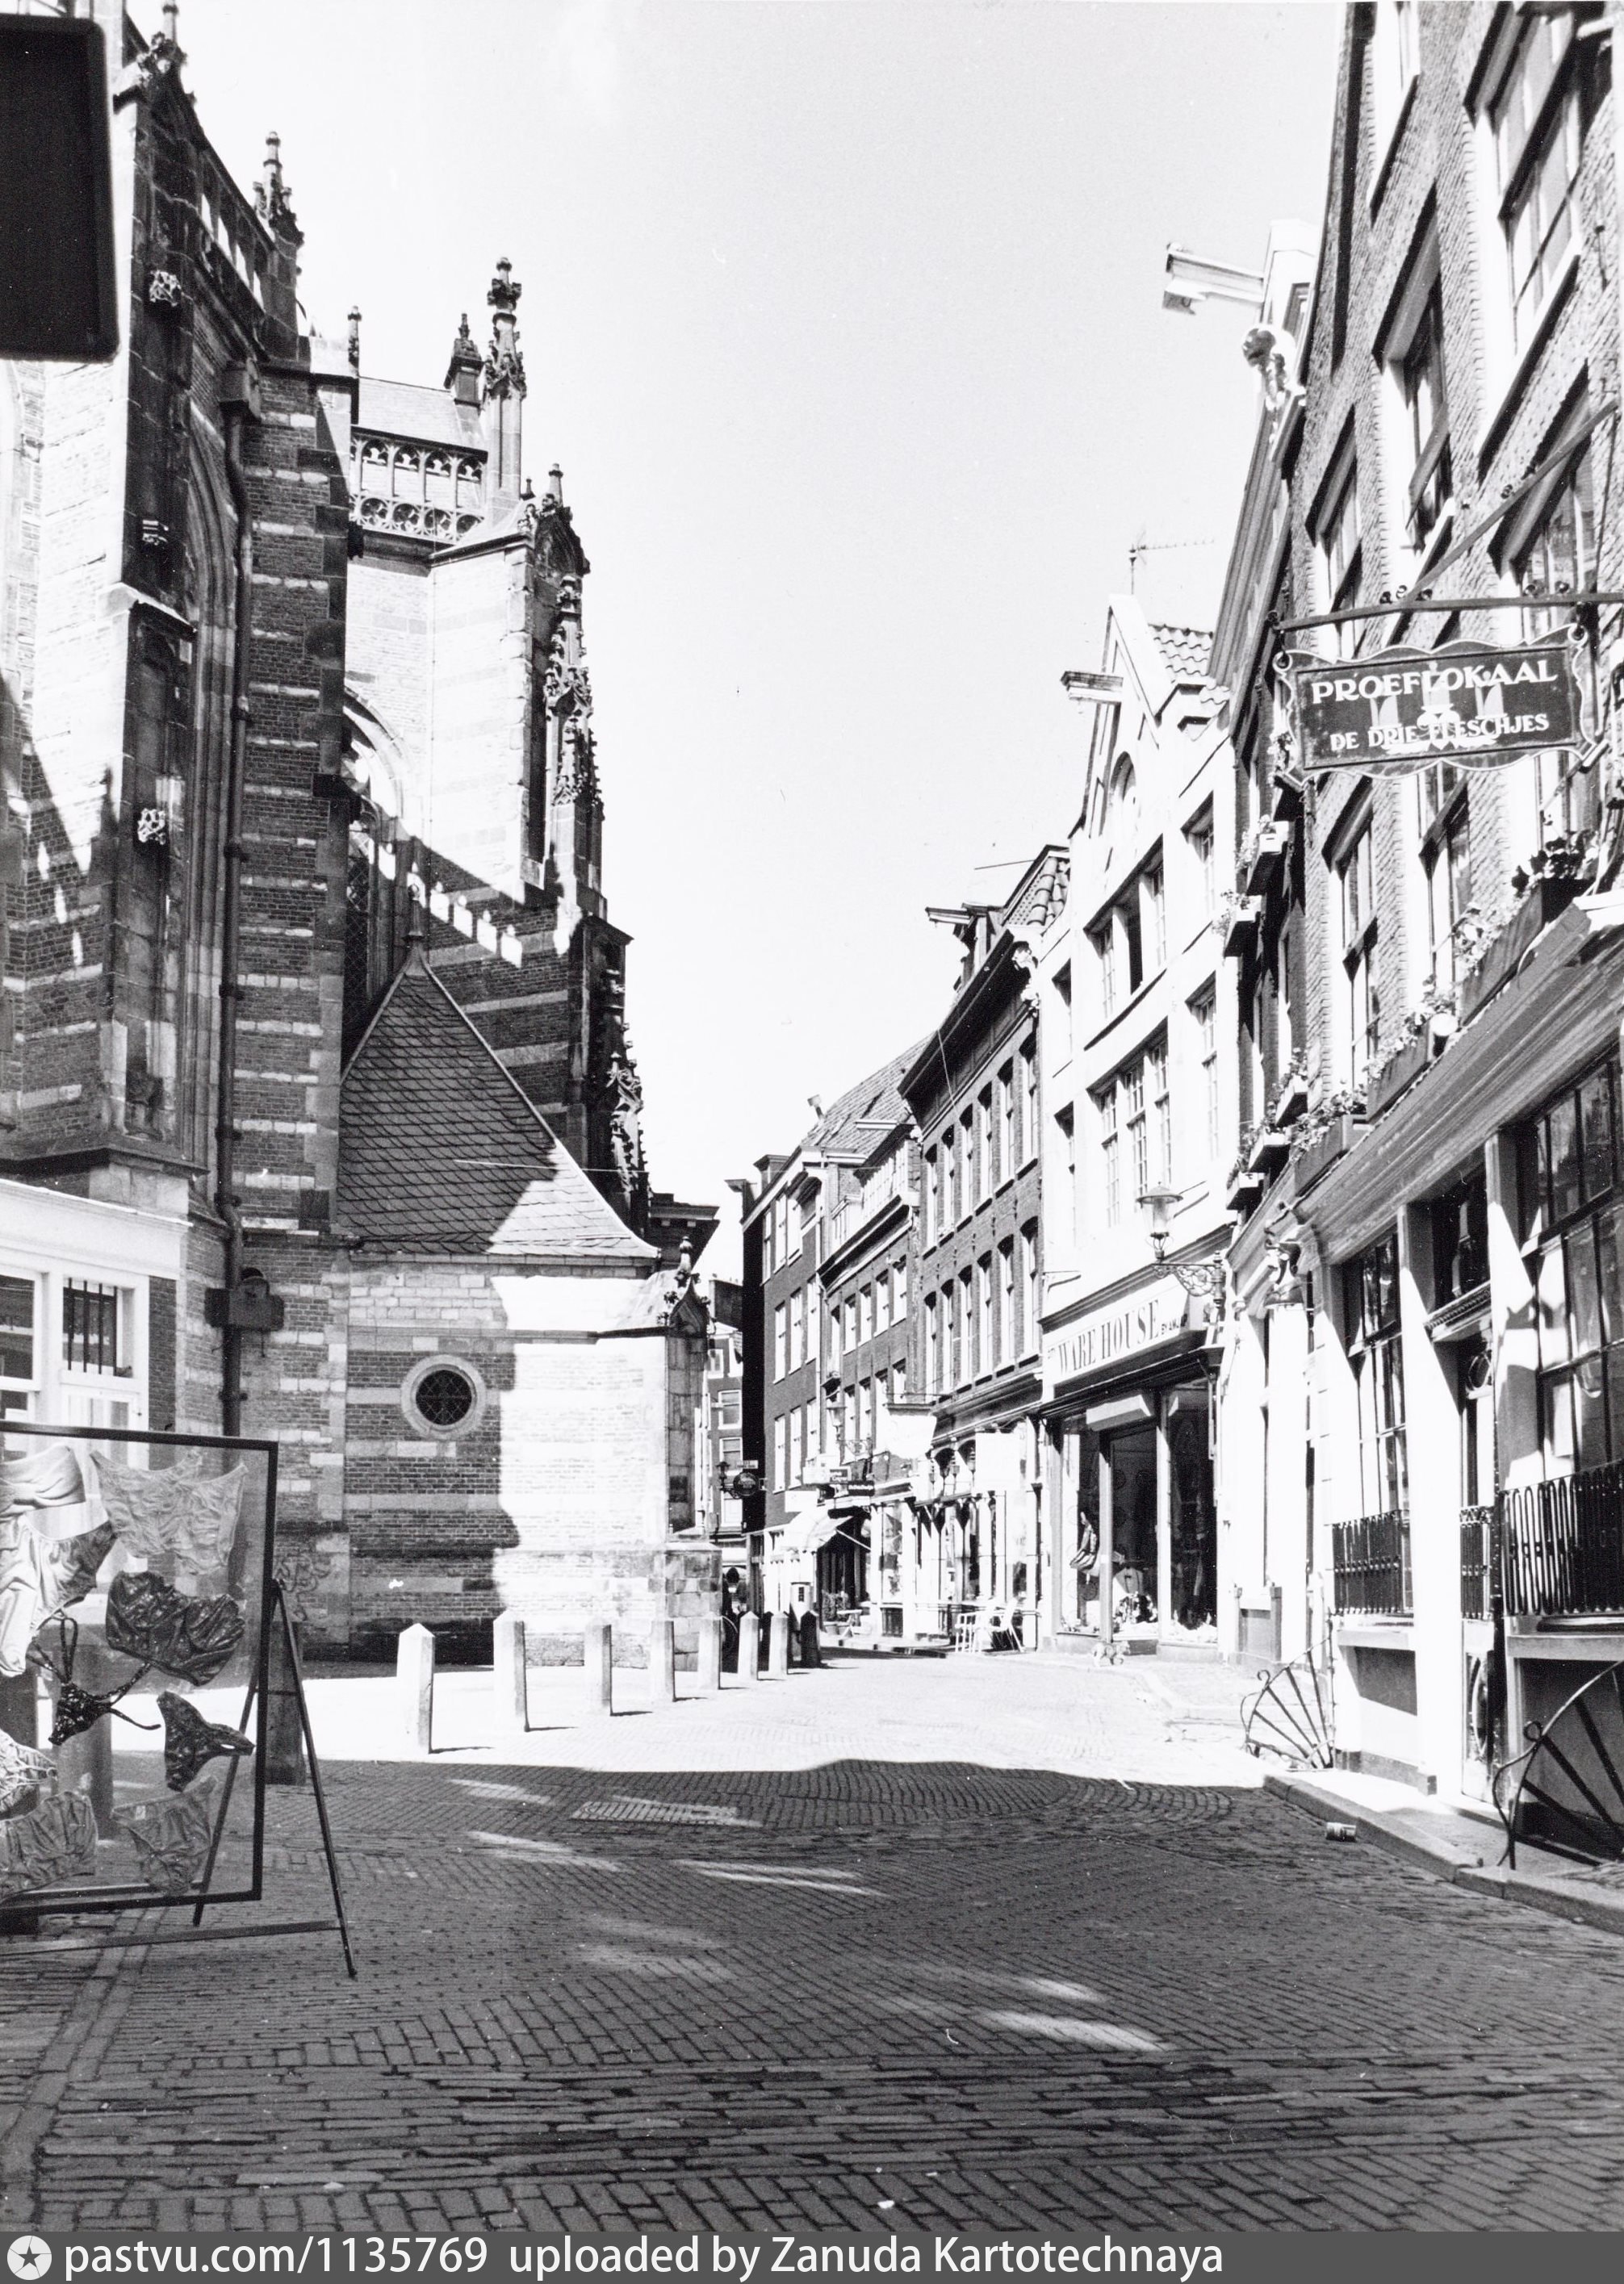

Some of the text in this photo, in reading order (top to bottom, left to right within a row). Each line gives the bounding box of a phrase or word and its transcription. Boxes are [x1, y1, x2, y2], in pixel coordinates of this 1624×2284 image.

[1311, 659, 1559, 705] PROEFLOKAAL
[1329, 731, 1360, 751] DE
[1367, 725, 1419, 747] DRIE
